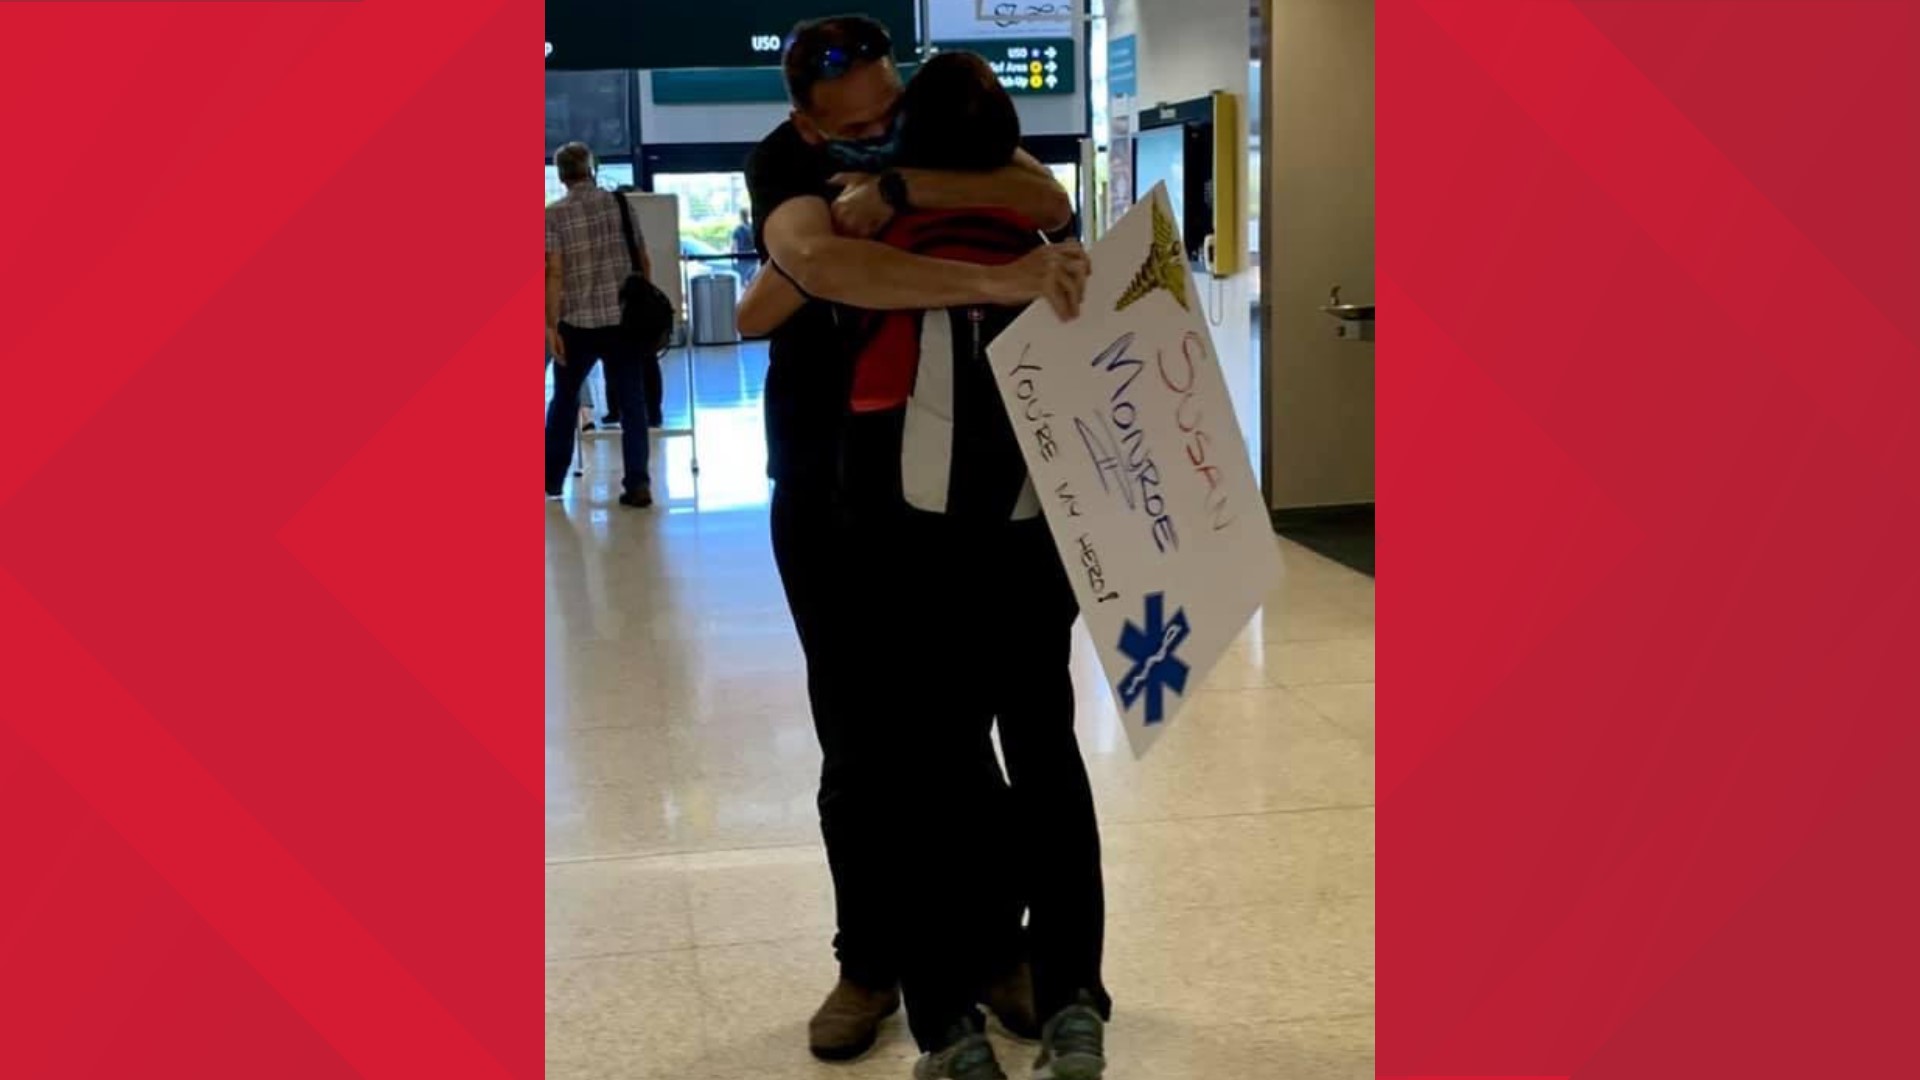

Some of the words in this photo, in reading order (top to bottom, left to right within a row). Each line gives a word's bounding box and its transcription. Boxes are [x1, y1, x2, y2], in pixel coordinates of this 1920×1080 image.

[751, 35, 781, 51] USO
[1008, 342, 1058, 462] YOU'RE
[1055, 481, 1082, 517] MY
[1079, 532, 1119, 602] HERO!
[1091, 331, 1179, 553] MONROE
[1157, 331, 1237, 532] SUSAN
